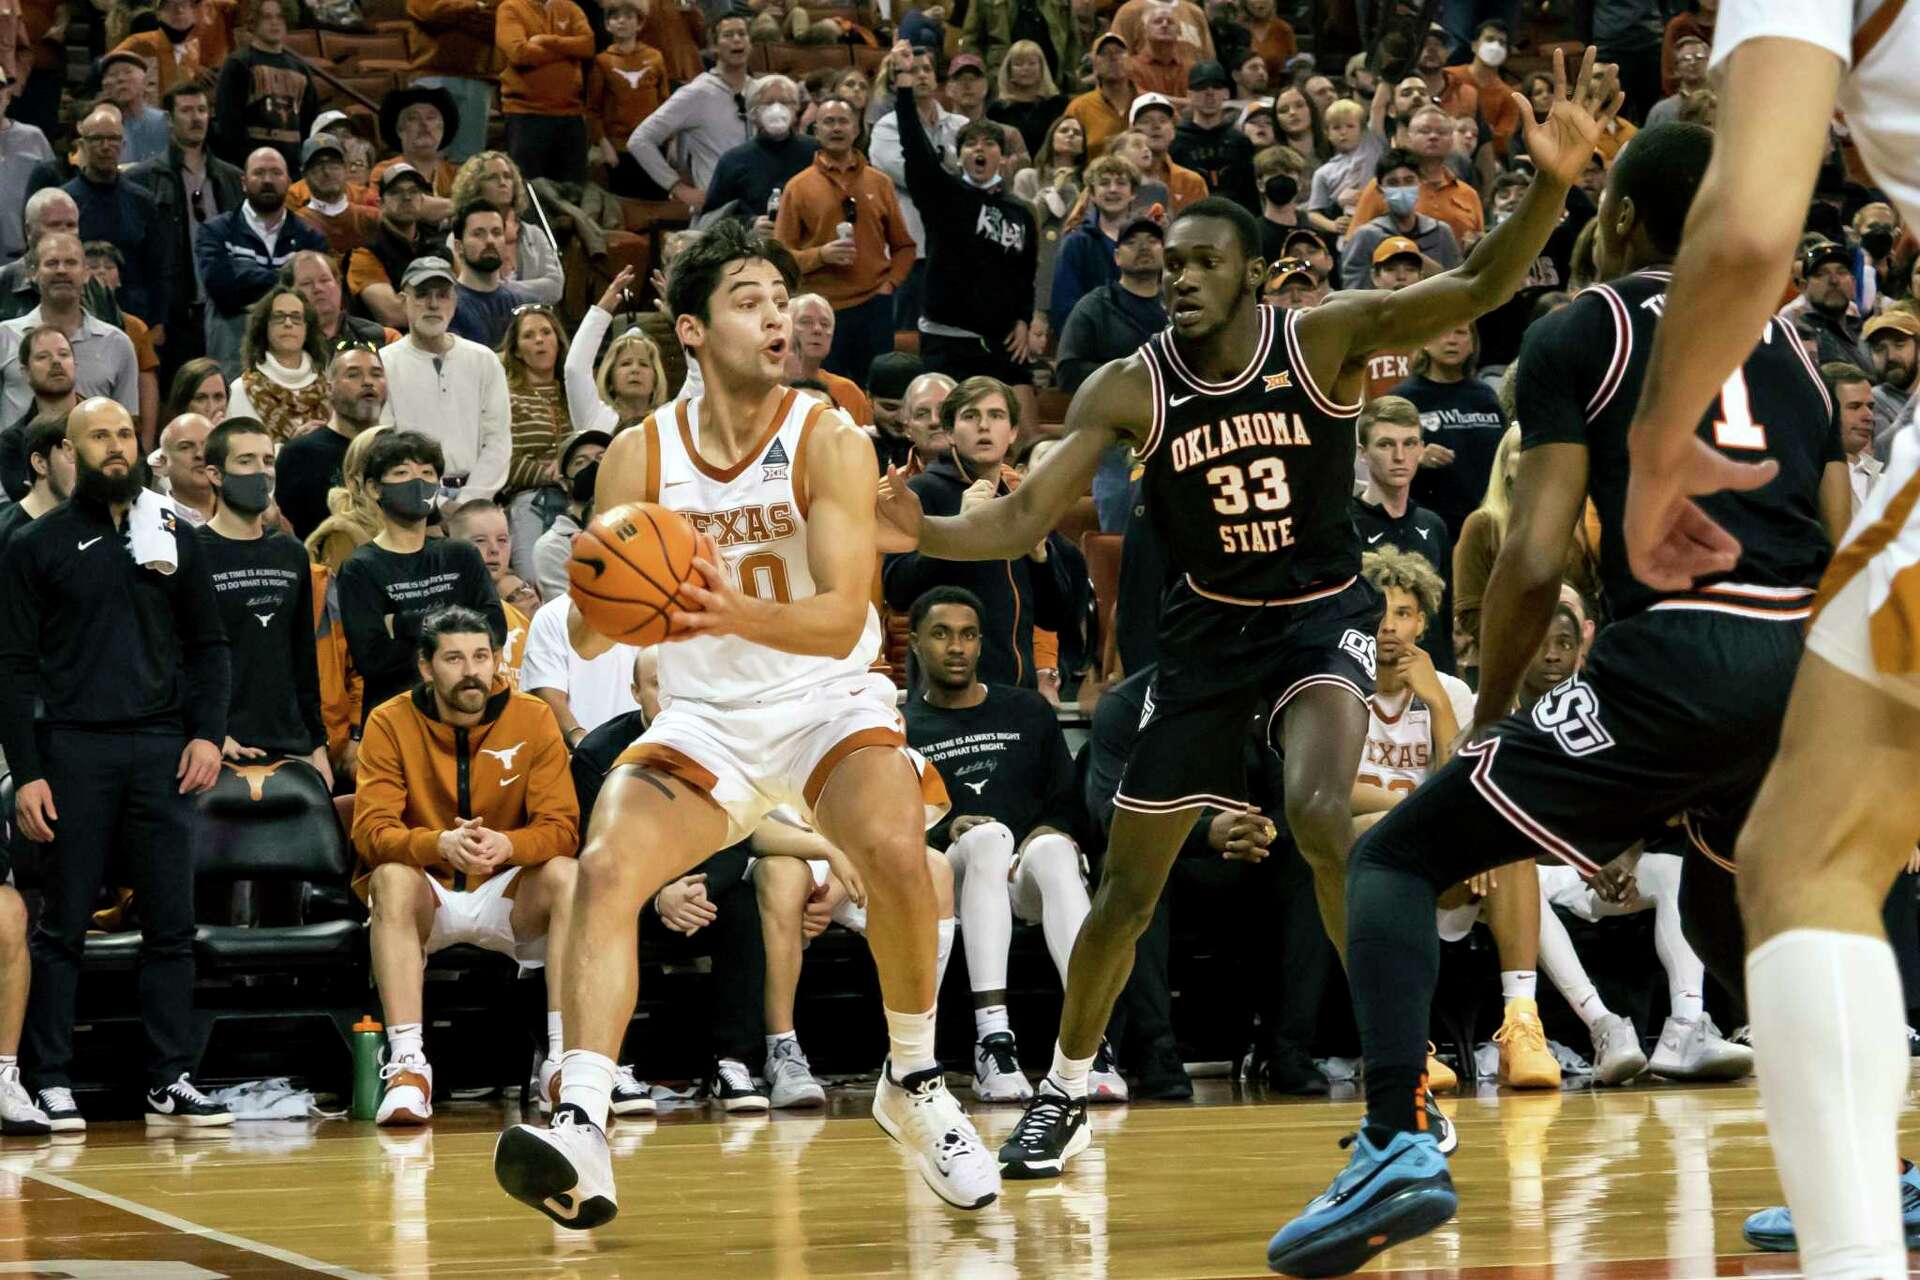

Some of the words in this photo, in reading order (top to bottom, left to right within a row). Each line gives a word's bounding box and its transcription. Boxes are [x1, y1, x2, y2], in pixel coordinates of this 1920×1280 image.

[1368, 355, 1409, 379] TEX
[1438, 408, 1500, 424] Wharton
[1712, 366, 1768, 451] 1
[1171, 411, 1312, 473] OKLAHOMA
[1206, 456, 1291, 515] 33
[680, 502, 796, 547] EXAS
[1219, 516, 1295, 553] STATE
[212, 573, 229, 582] THE
[230, 570, 247, 579] TIME
[247, 569, 255, 577] IS
[255, 568, 281, 577] ALWAYS
[214, 583, 227, 592] TO
[228, 581, 240, 590] DO
[239, 579, 260, 588] WHAT
[1531, 673, 1616, 757] SU
[918, 744, 935, 755] THE
[935, 739, 956, 751] TIME
[955, 736, 964, 746] IS
[964, 732, 997, 744] ALWAYS
[996, 732, 1021, 741] RIGHT
[933, 752, 947, 762] DO
[946, 745, 971, 758] WHAT
[971, 744, 980, 753] IS
[980, 742, 1008, 752] RIGHT.
[1366, 737, 1428, 769] EXAS
